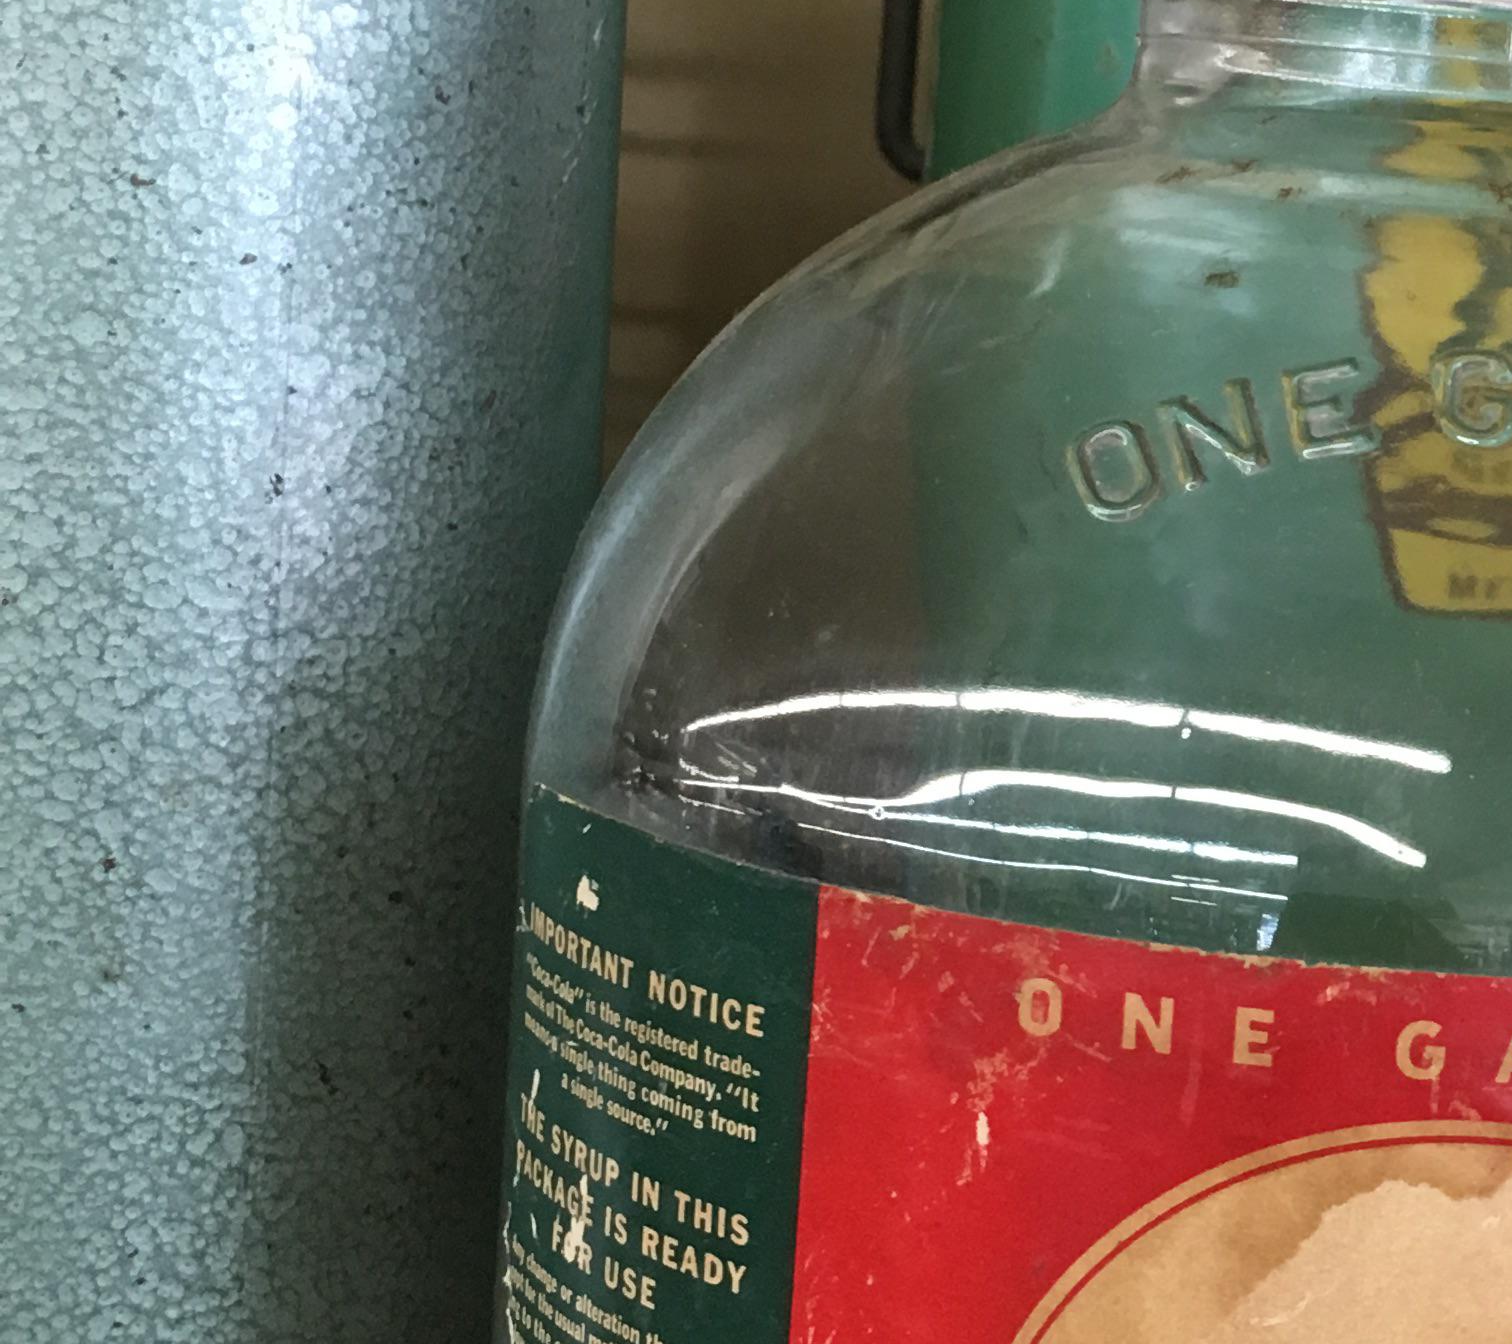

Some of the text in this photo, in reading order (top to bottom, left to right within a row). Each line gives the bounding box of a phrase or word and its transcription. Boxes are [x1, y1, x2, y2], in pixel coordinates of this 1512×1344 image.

[1064, 354, 1384, 525] ONE
[530, 901, 765, 1038] IMPORTANT NOTICE
[576, 1018, 638, 1066] Coca-Cola
[640, 1050, 722, 1102] Company.
[585, 992, 596, 1016] is
[600, 1001, 621, 1028] the
[624, 1016, 699, 1061] registered
[704, 1045, 761, 1079] trade-
[1016, 976, 1276, 1068] ONE
[561, 1072, 568, 1090] a
[570, 1076, 604, 1110] single
[597, 1061, 636, 1100] thing
[641, 1086, 704, 1129] coming
[709, 1109, 757, 1143] from
[521, 1092, 749, 1247] THE SYRUP IN THIS
[516, 1138, 747, 1294] PACKAGE IS READY
[560, 1285, 573, 1304] or
[604, 1256, 657, 1310] USE
[554, 1310, 586, 1343] usual
